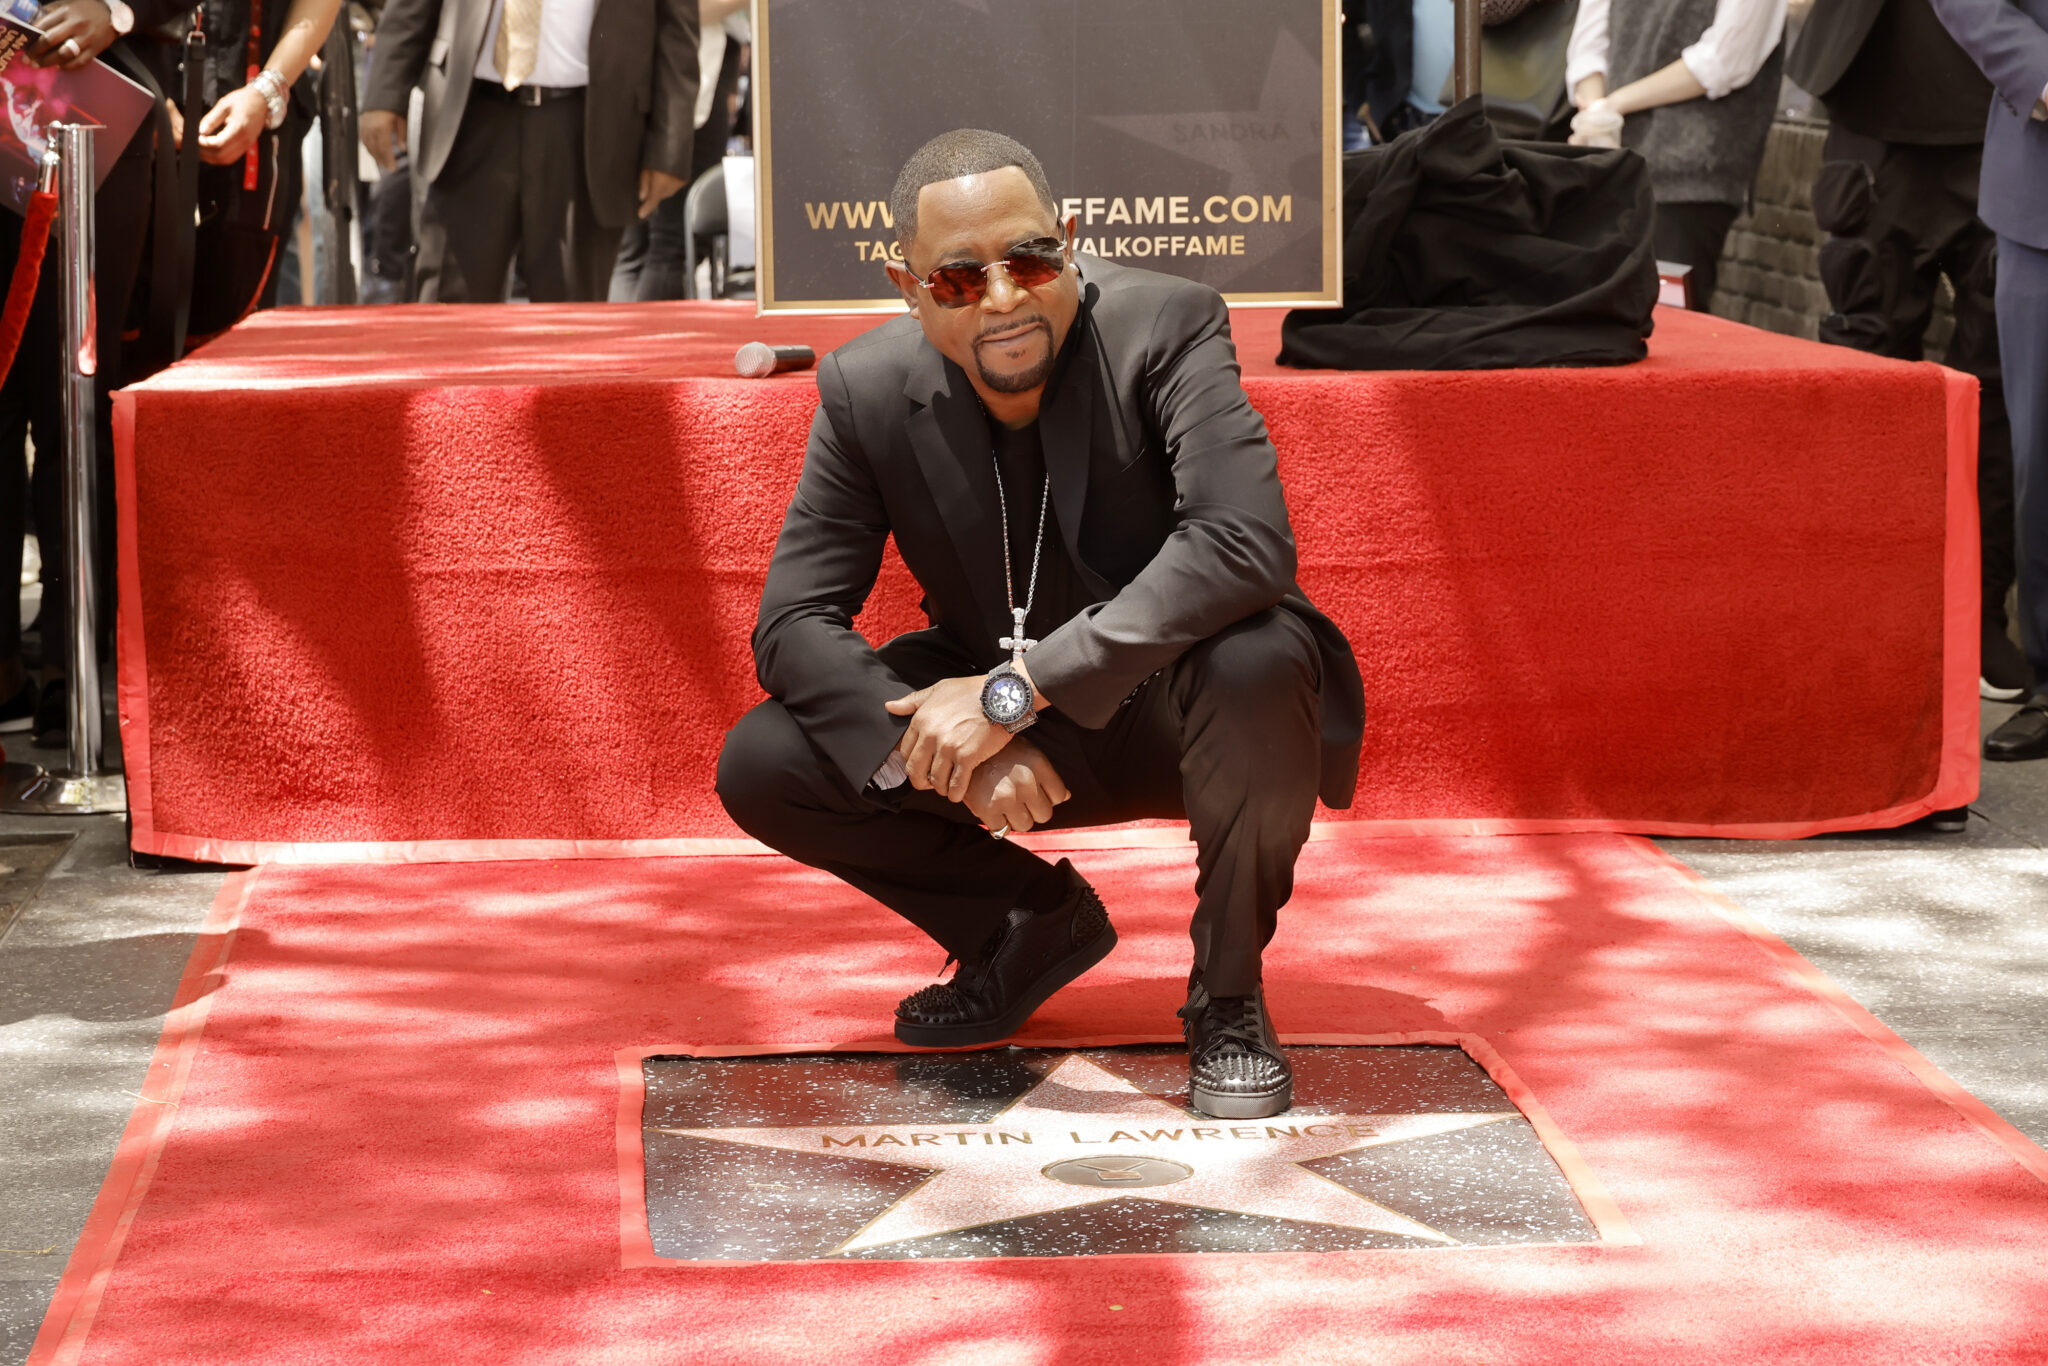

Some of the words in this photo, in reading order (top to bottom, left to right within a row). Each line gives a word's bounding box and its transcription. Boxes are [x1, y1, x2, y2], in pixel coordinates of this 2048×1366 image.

[1172, 121, 1291, 143] SANDRA
[1053, 194, 1293, 226] FFAME.COM
[1072, 234, 1246, 258] ALKOFFAME
[821, 1131, 1034, 1148] MARTIN
[1069, 1124, 1380, 1144] LAWRENCE
